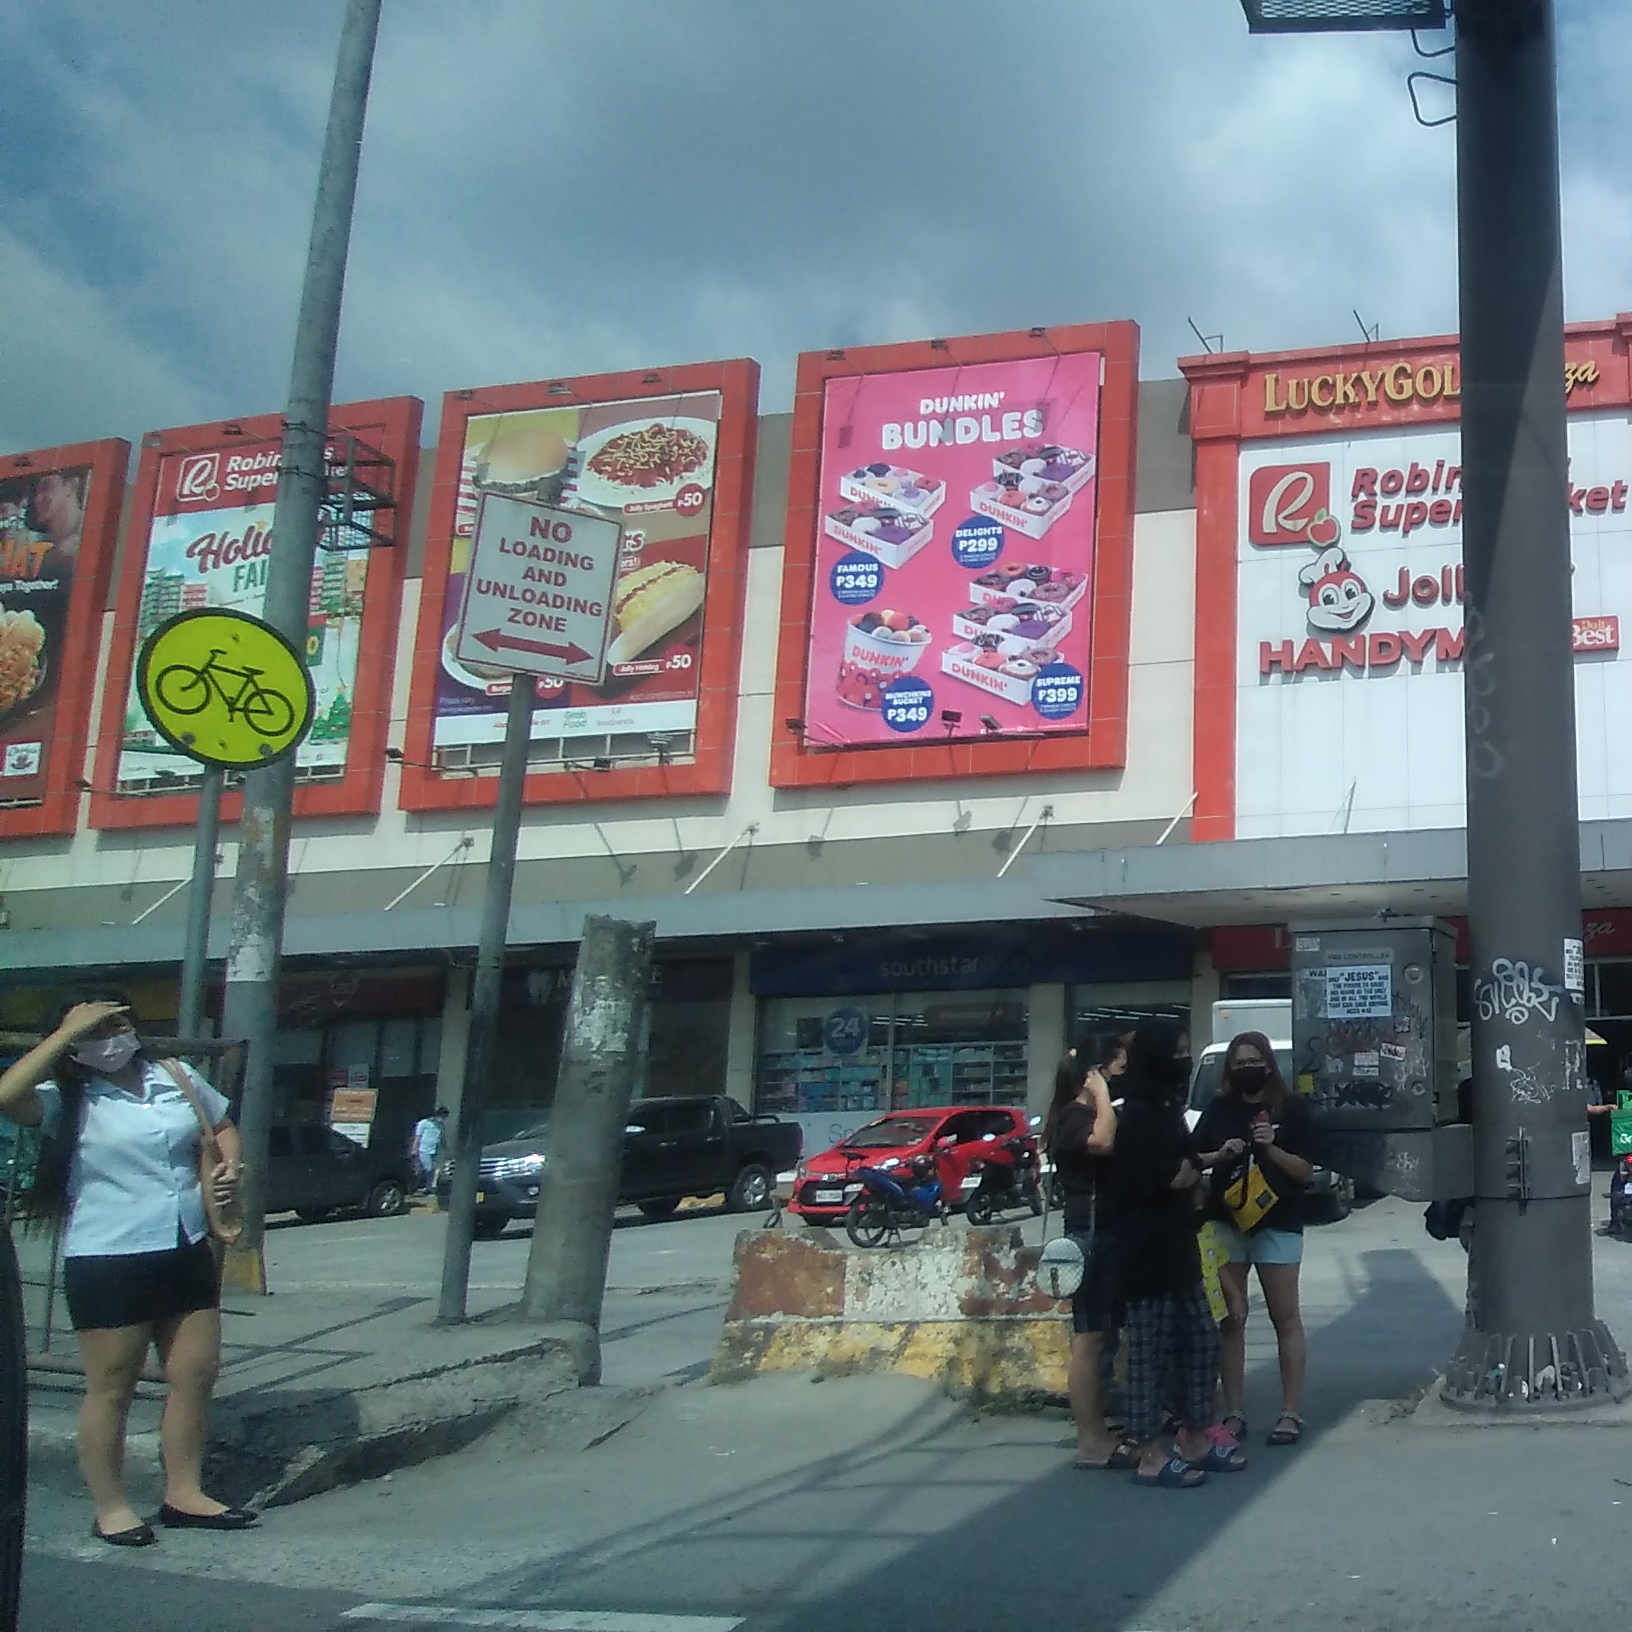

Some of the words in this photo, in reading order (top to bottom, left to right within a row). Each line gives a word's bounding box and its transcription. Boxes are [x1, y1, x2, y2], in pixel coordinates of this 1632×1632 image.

[1264, 362, 1461, 412] LUCKYGOL
[919, 391, 1005, 415] DUNKIN'
[881, 409, 1043, 450] BUNDLES
[530, 516, 573, 543] NO
[955, 526, 1003, 538] DELIGHTS
[500, 538, 594, 571] LOADING
[522, 566, 568, 587] AND
[837, 563, 879, 573] FAMOUS
[476, 579, 603, 617] UNLOADING
[507, 608, 568, 632] ZONE
[1260, 627, 1464, 674] HANDYM
[1036, 675, 1081, 687] SUPREME
[879, 957, 980, 977] southstar
[831, 1016, 861, 1039] 24
